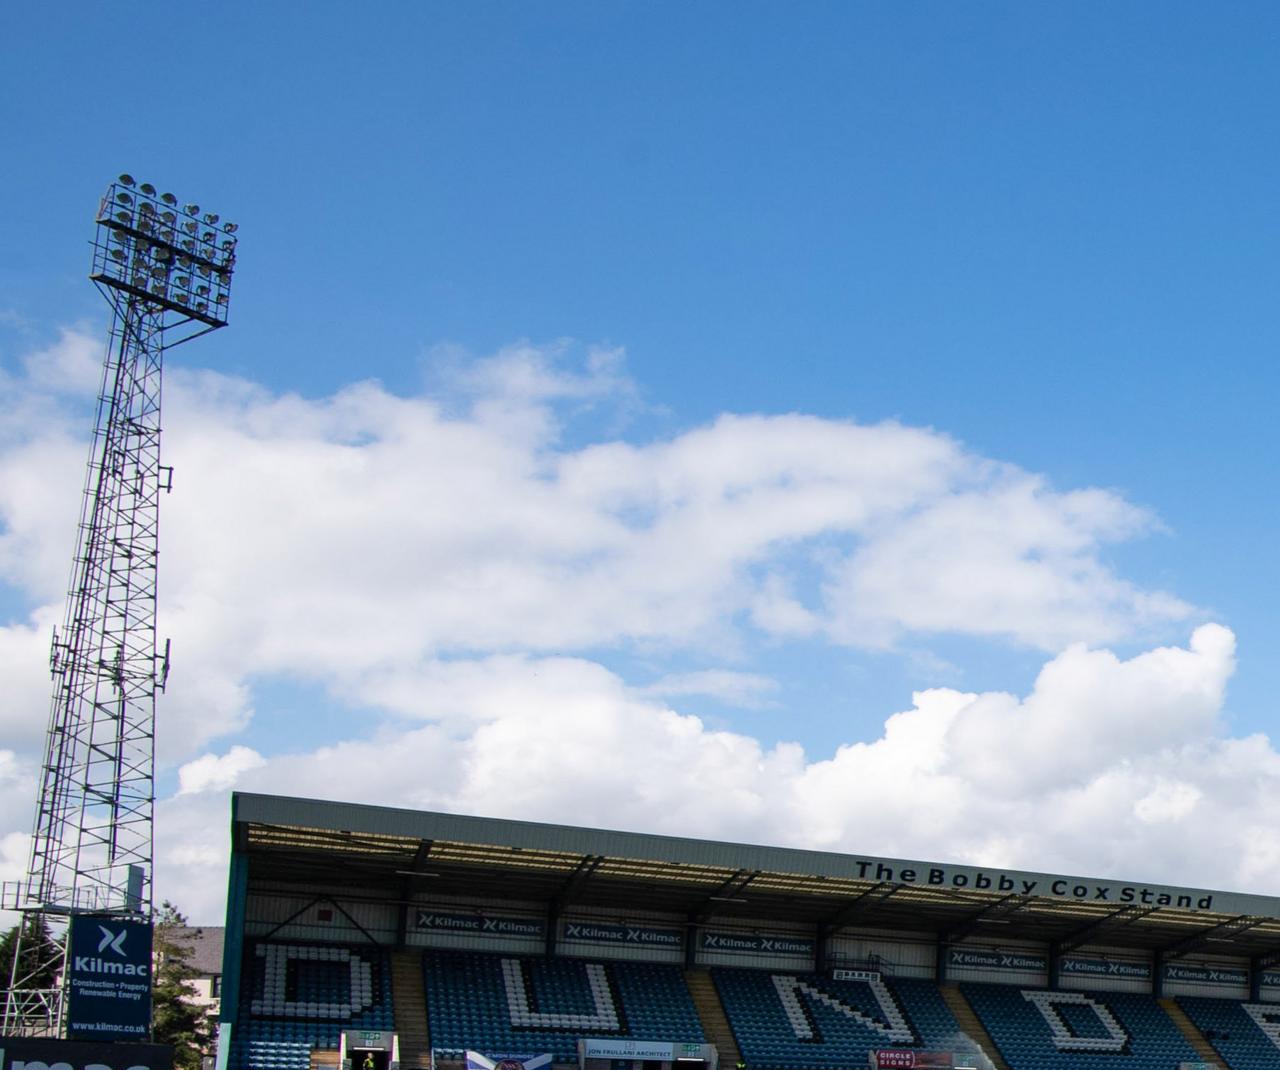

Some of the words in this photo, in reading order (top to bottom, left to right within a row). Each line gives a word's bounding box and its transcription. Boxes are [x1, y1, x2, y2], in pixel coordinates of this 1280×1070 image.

[856, 861, 917, 882] The
[928, 868, 1037, 895] Bobby
[1051, 880, 1109, 900] Cox
[1119, 887, 1213, 909] Stand
[435, 915, 479, 928] Kilmac
[499, 920, 542, 933] Kilmac
[582, 923, 623, 939] Kilmac
[642, 928, 681, 943] Kilmac
[719, 938, 757, 949] Kilmac
[775, 941, 812, 952] Kilmac
[75, 956, 147, 976] Kilmac
[964, 953, 998, 965] Kilmac
[1011, 956, 1045, 968] Kilmac
[1074, 962, 1106, 973] Kilmac
[1119, 965, 1149, 976] Kilmac
[1178, 969, 1206, 980] Kilmac
[1219, 971, 1248, 982] Kilmac
[72, 978, 115, 989] Construction
[120, 982, 149, 992] Property
[118, 991, 142, 1001] Energy
[880, 1052, 911, 1060] CIRCLE
[880, 1059, 911, 1067] SIGNS
